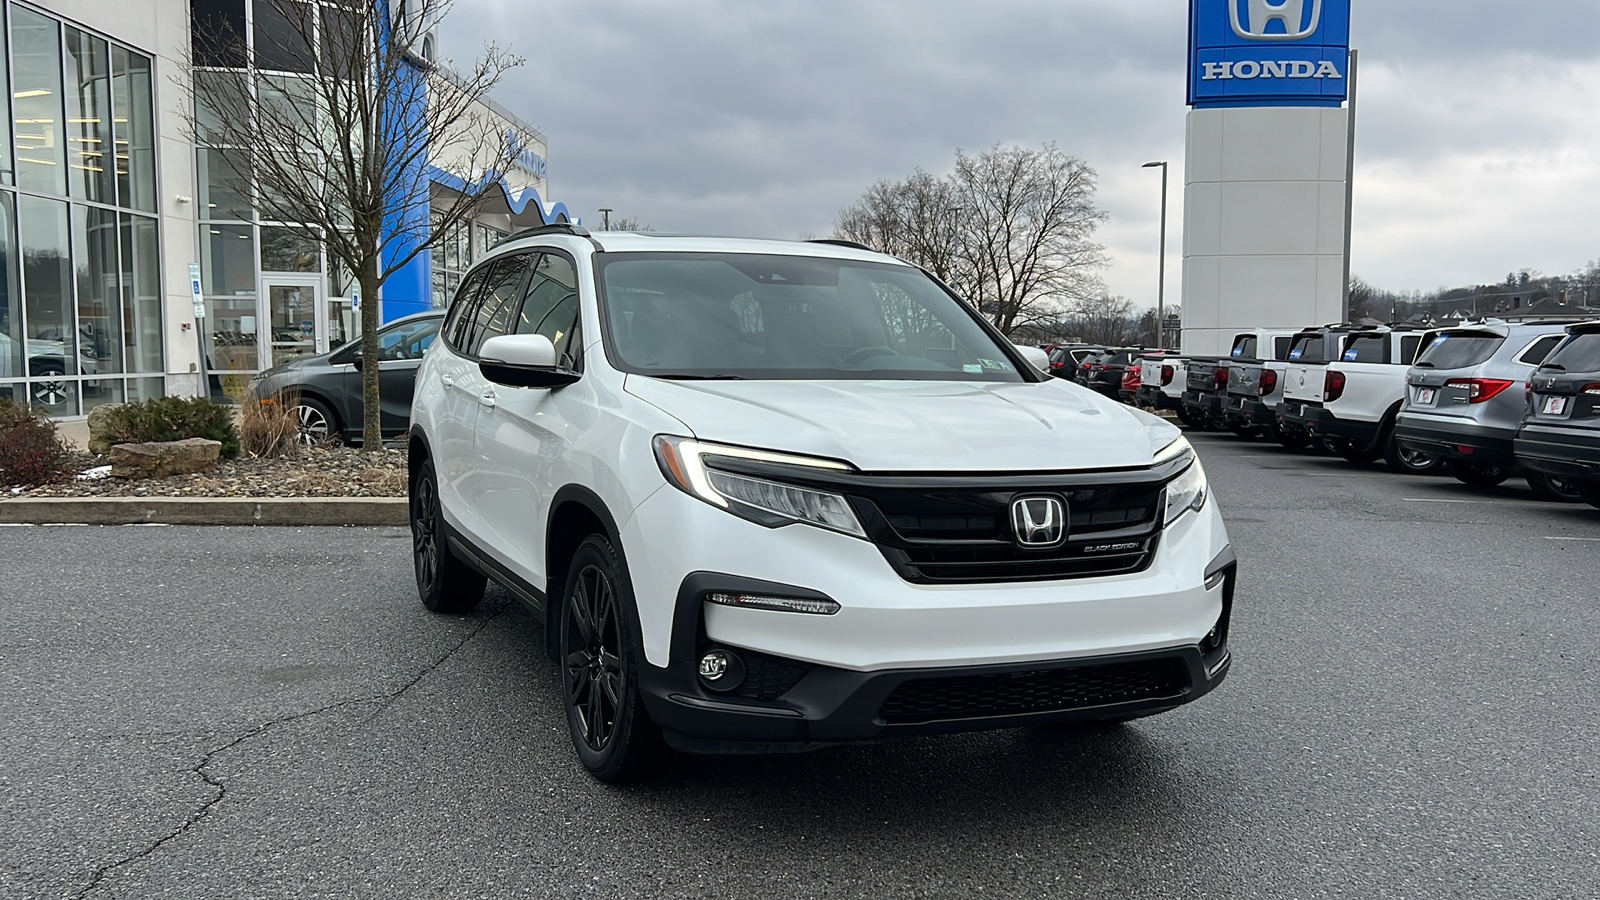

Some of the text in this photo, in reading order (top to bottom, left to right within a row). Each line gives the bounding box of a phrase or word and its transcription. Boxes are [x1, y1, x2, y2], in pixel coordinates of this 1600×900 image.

[1202, 60, 1342, 80] HONDA
[1084, 542, 1139, 552] BLACK EDITION
